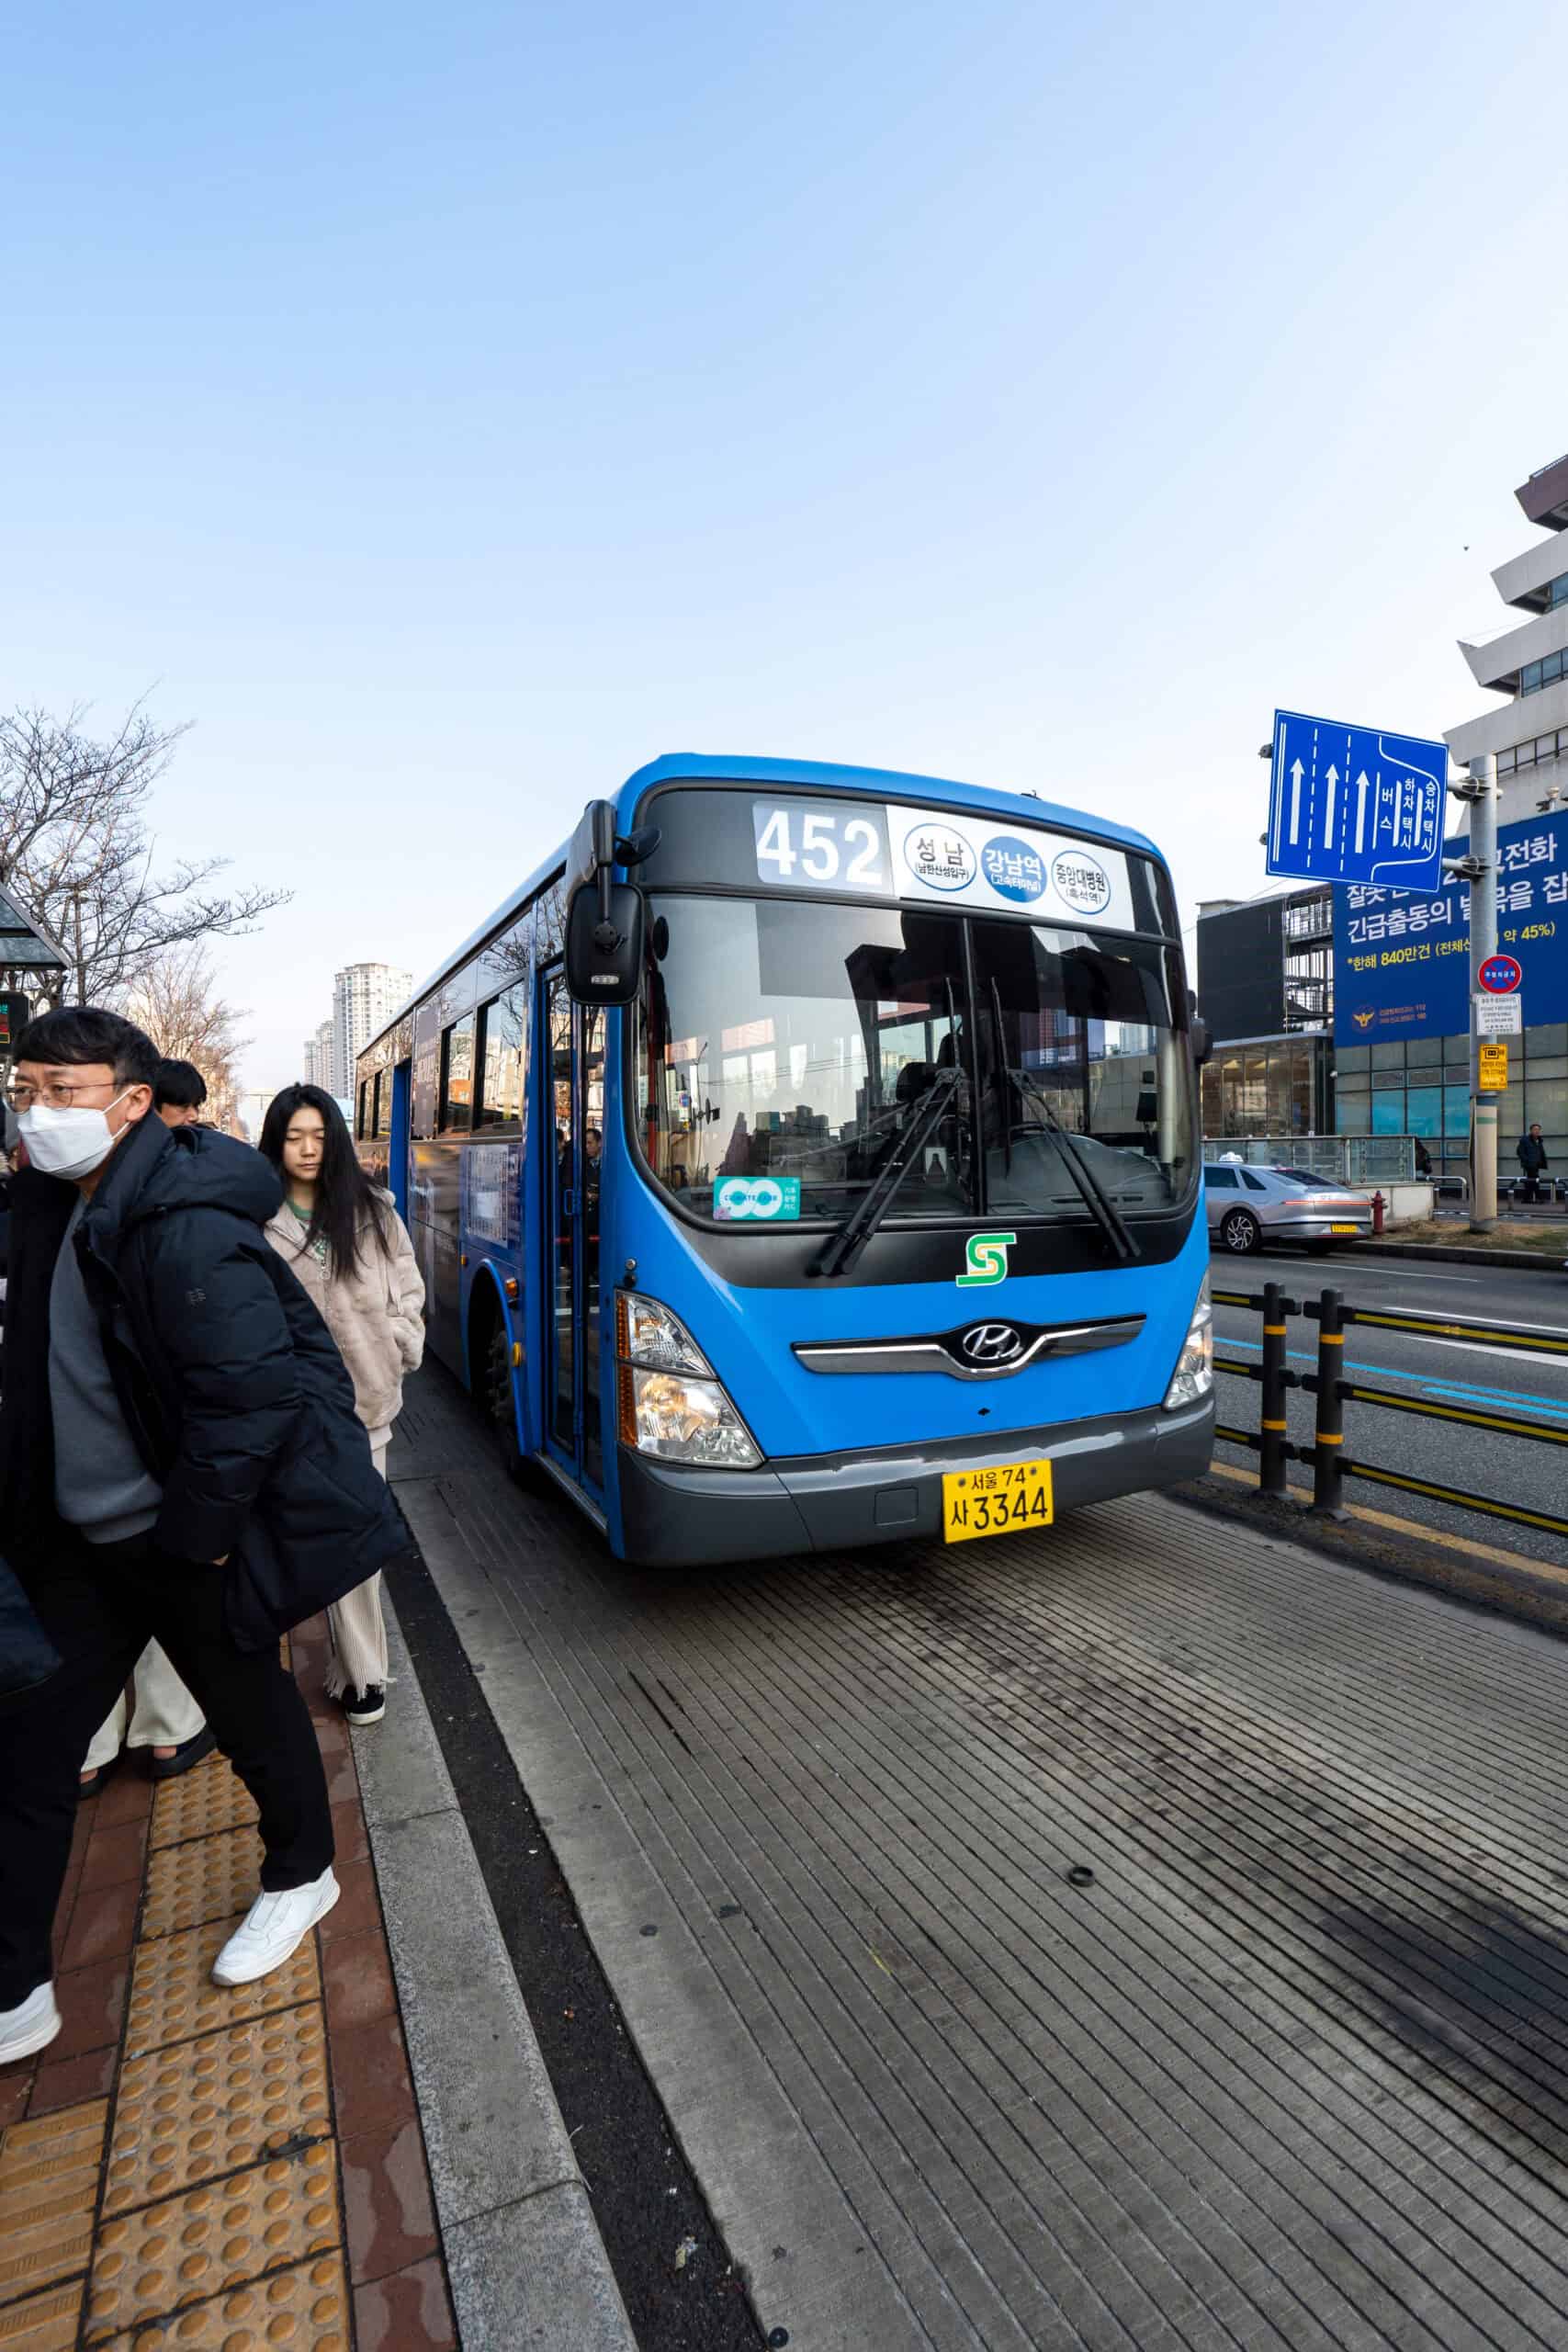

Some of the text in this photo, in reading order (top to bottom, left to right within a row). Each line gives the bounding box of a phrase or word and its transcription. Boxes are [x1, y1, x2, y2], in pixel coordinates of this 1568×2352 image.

[1380, 787, 1393, 830] 버스
[1401, 777, 1416, 851] 하차 택시
[1421, 781, 1436, 854] 승차 택시
[756, 809, 883, 886] 452
[985, 849, 1043, 881] 강남역
[1348, 897, 1452, 944] 긴급출동의
[1520, 921, 1556, 941] 45%)
[971, 1466, 1026, 1491] 서울 74
